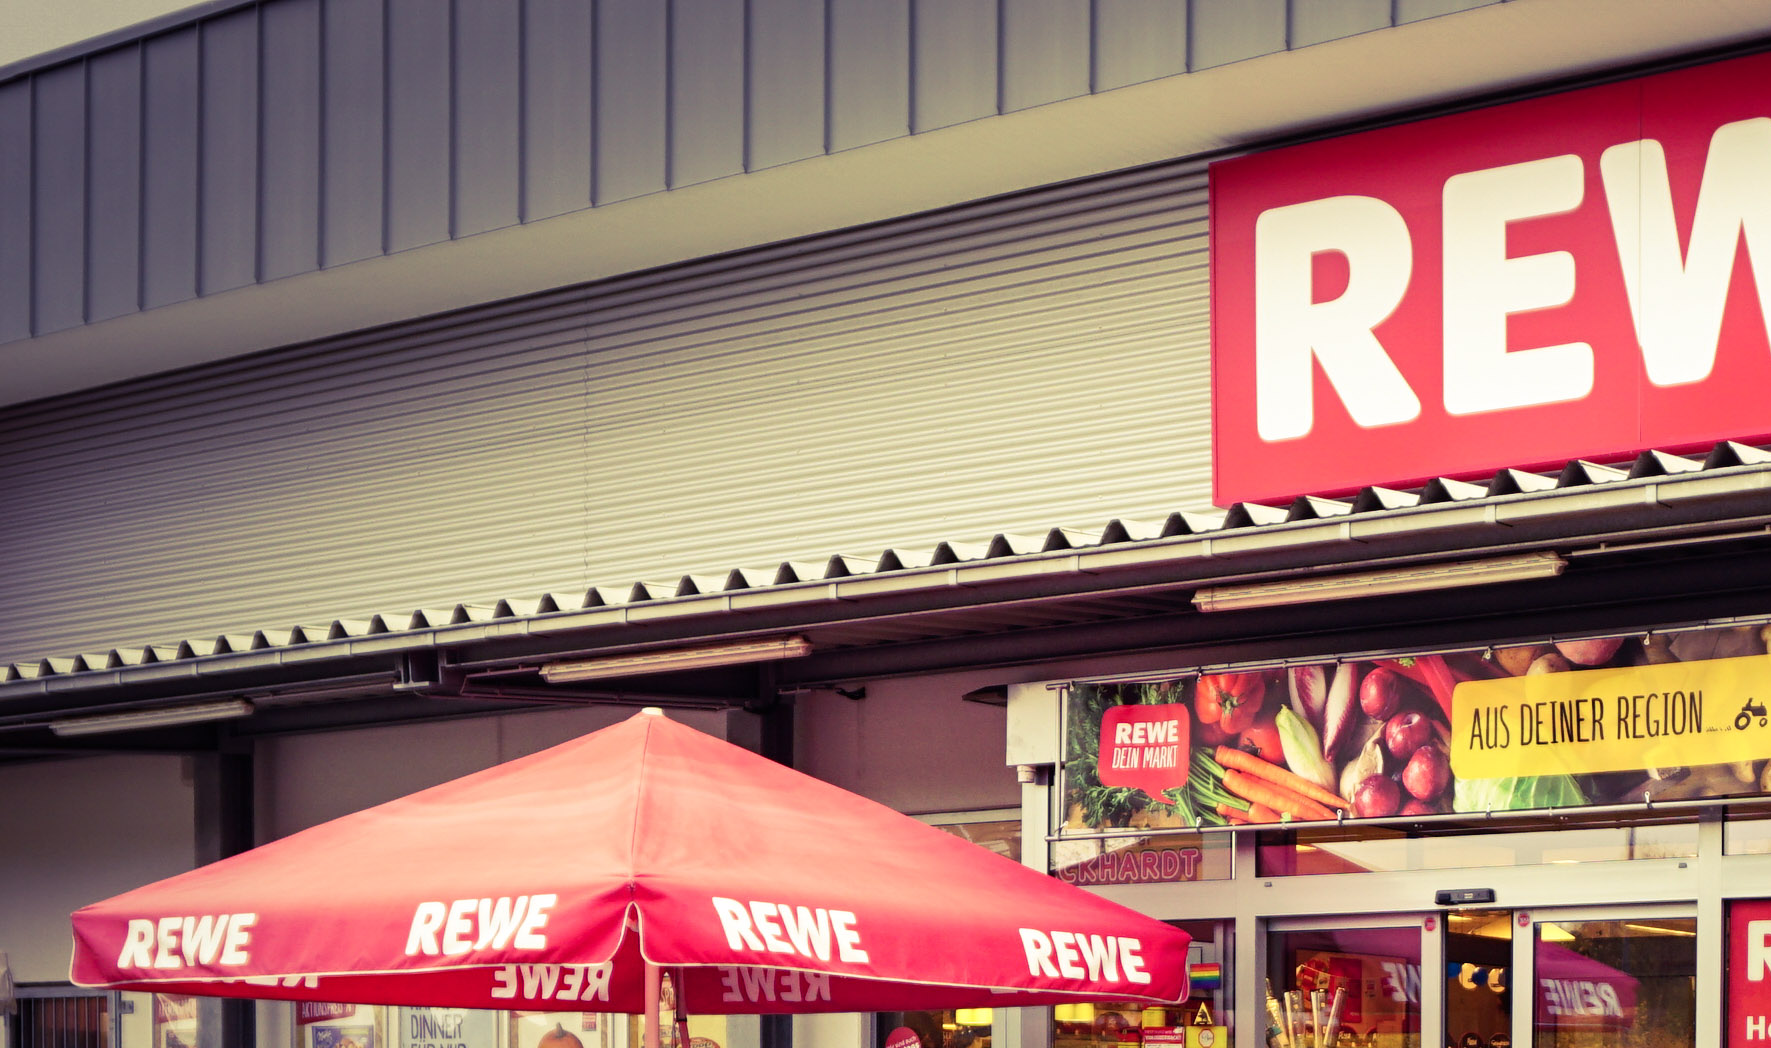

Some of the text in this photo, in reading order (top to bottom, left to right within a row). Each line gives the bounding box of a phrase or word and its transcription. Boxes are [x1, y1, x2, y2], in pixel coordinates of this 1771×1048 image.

[1114, 719, 1180, 745] REWE
[1468, 690, 1704, 750] AUS DEINER REGION
[1112, 745, 1178, 770] DEIN MARKT
[1058, 848, 1200, 884] CKHARDT
[117, 912, 256, 969] REWE
[405, 893, 557, 957] REWE
[712, 896, 870, 965] REWE
[1018, 927, 1152, 985] REWE
[411, 1014, 464, 1040] DINNER
